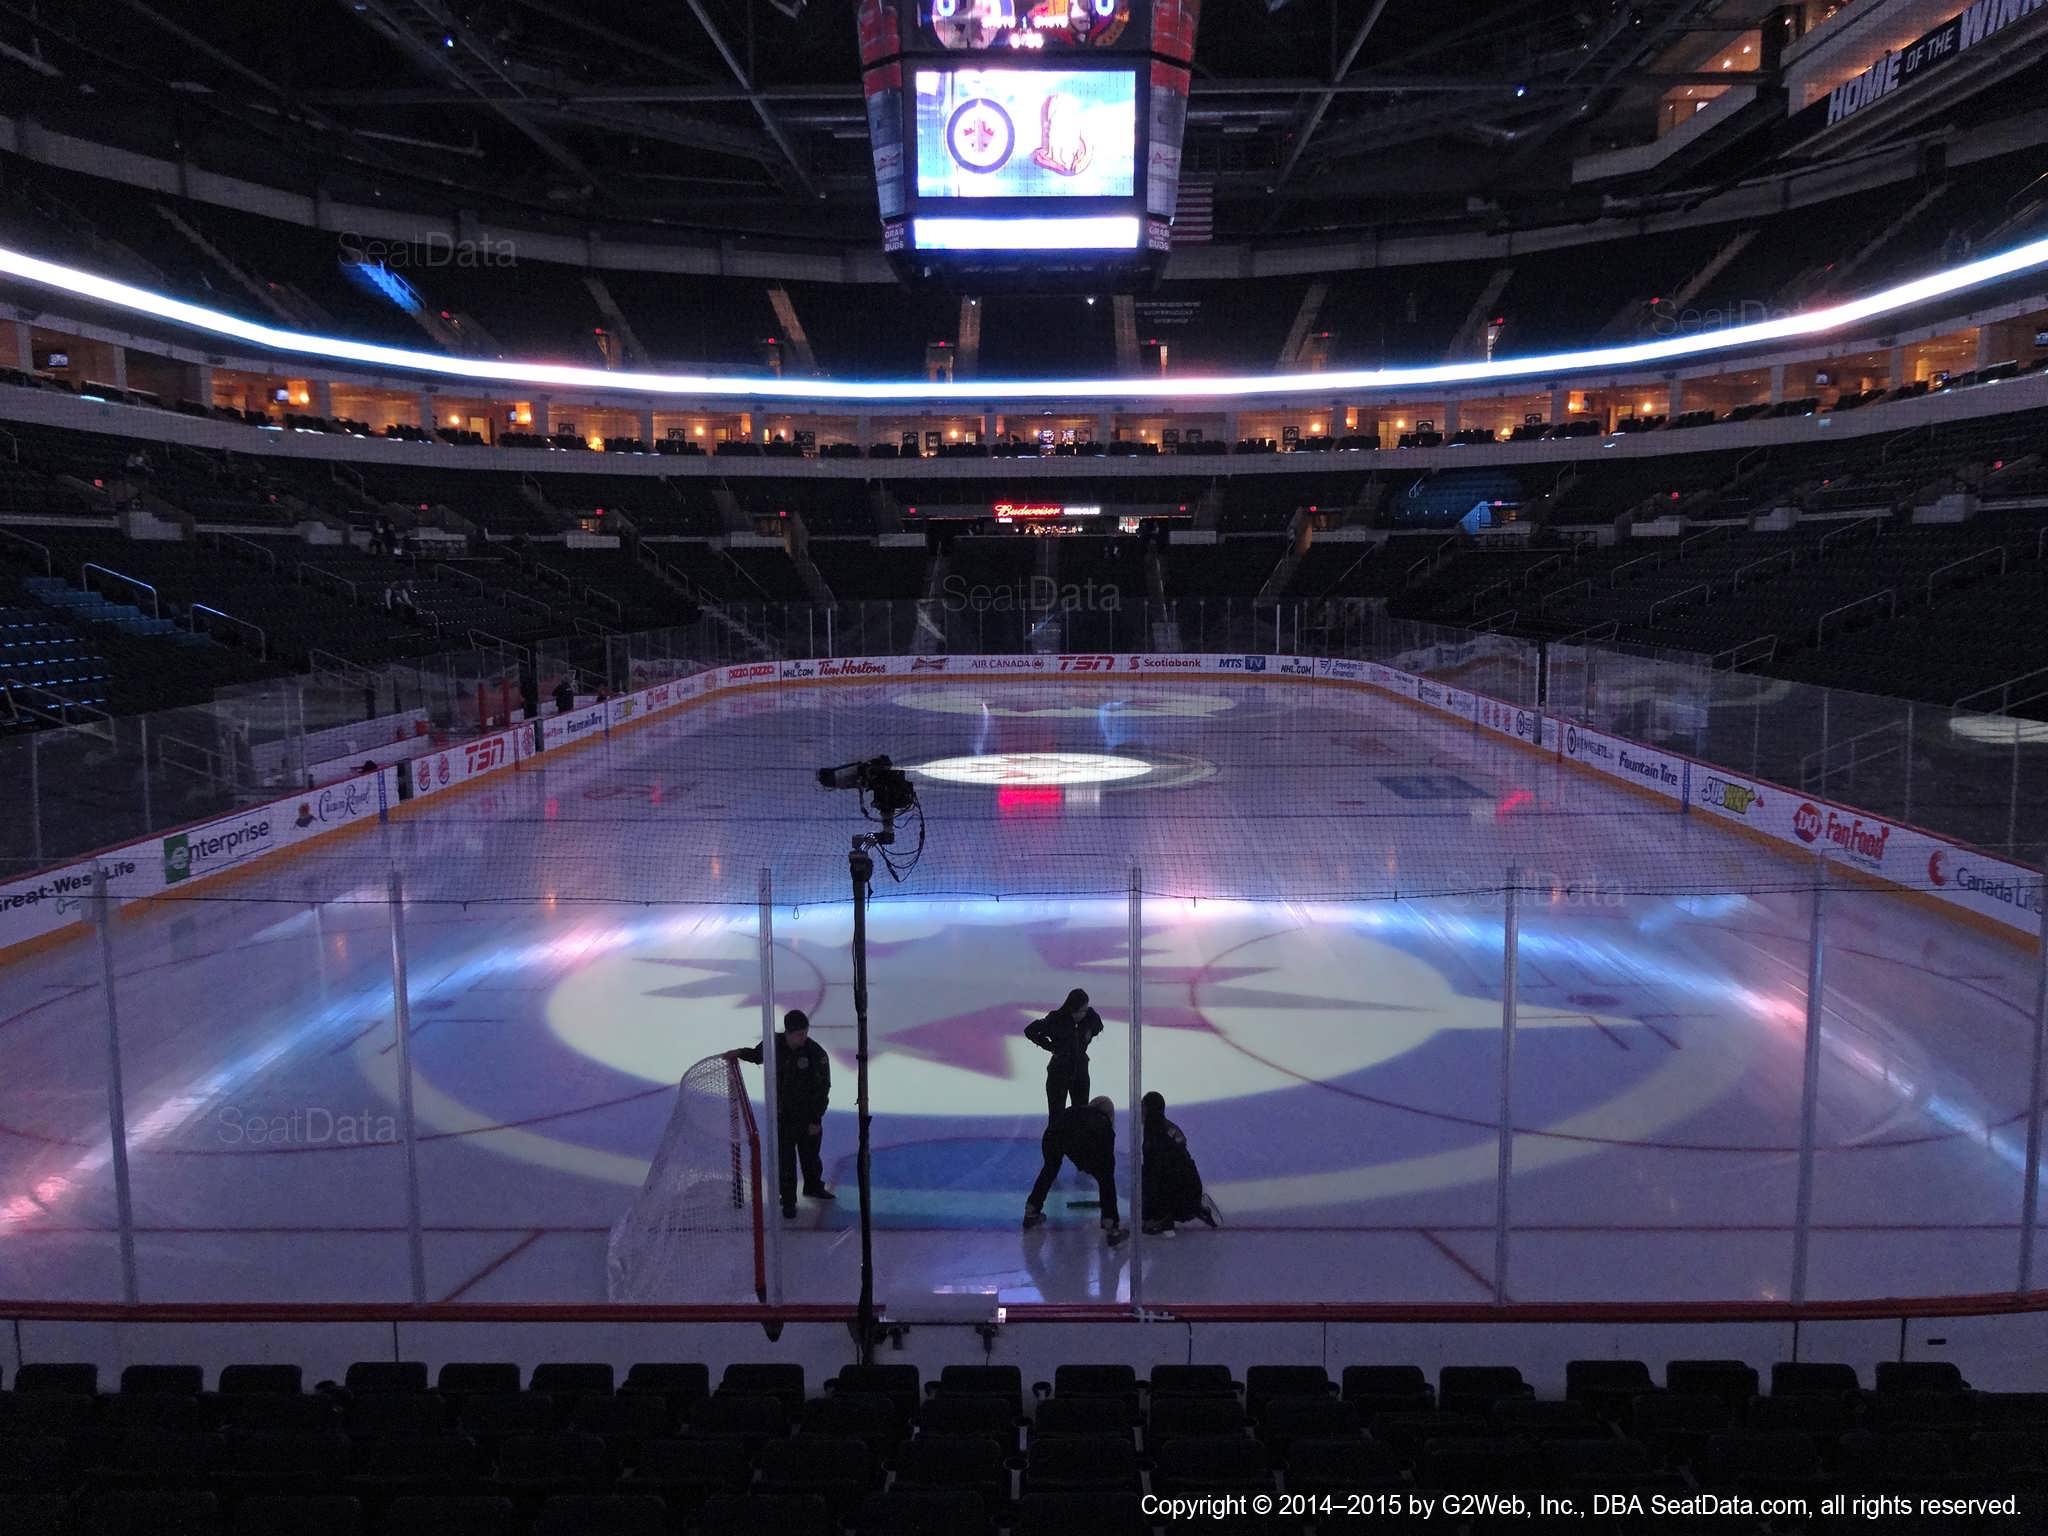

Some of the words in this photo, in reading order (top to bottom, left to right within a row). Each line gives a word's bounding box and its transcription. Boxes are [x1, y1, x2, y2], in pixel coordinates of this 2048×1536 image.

[1827, 52, 1903, 127] HOME
[1906, 52, 1922, 73] OF
[1928, 26, 1955, 61] THE
[995, 504, 1061, 517] Budweiser
[818, 660, 840, 675] Tim
[840, 659, 886, 675] Hortons
[972, 659, 988, 669] AIR
[989, 659, 1031, 669] CANADA
[1057, 655, 1115, 670] TSN
[1143, 658, 1201, 668] Scotiabank
[1219, 658, 1242, 669] MTS
[1281, 665, 1312, 674] NHL.COM
[728, 667, 749, 680] pizza
[750, 665, 775, 680] pizza
[465, 737, 505, 774] TSN
[1619, 750, 1659, 779] Fountain
[1660, 763, 1678, 786] Tire
[1826, 812, 1851, 849] Fan
[1851, 820, 1887, 861] Food
[170, 821, 269, 870] enterprise
[0, 873, 96, 914] reat-Wes
[104, 861, 137, 881] Life
[1957, 866, 2013, 904] Canada
